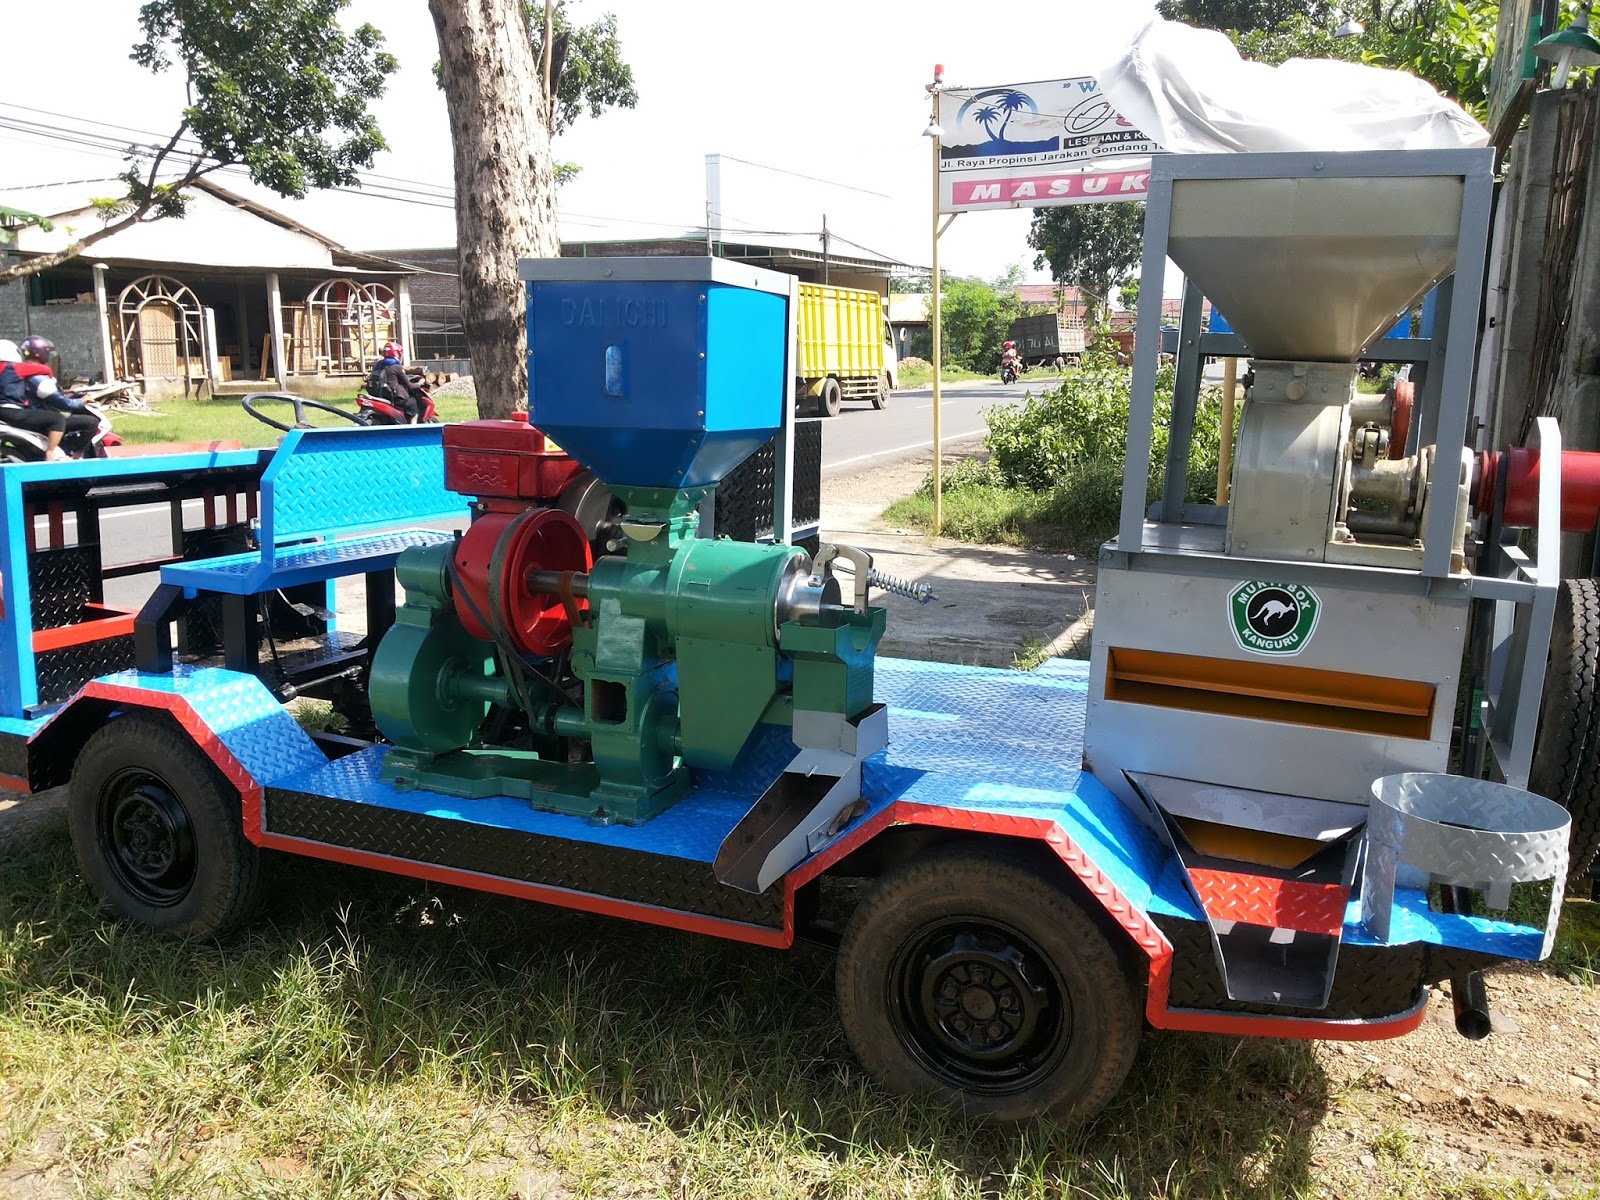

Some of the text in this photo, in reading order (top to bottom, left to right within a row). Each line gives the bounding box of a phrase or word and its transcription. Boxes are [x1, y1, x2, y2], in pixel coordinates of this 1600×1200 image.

[957, 159, 985, 167] Raya
[989, 155, 1037, 166] Propinsi
[1041, 150, 1087, 161] Jarakan
[1092, 143, 1148, 154] Gondang
[969, 174, 1150, 201] MASUK
[1286, 584, 1311, 610] BOX
[1241, 628, 1299, 649] KANGURU
